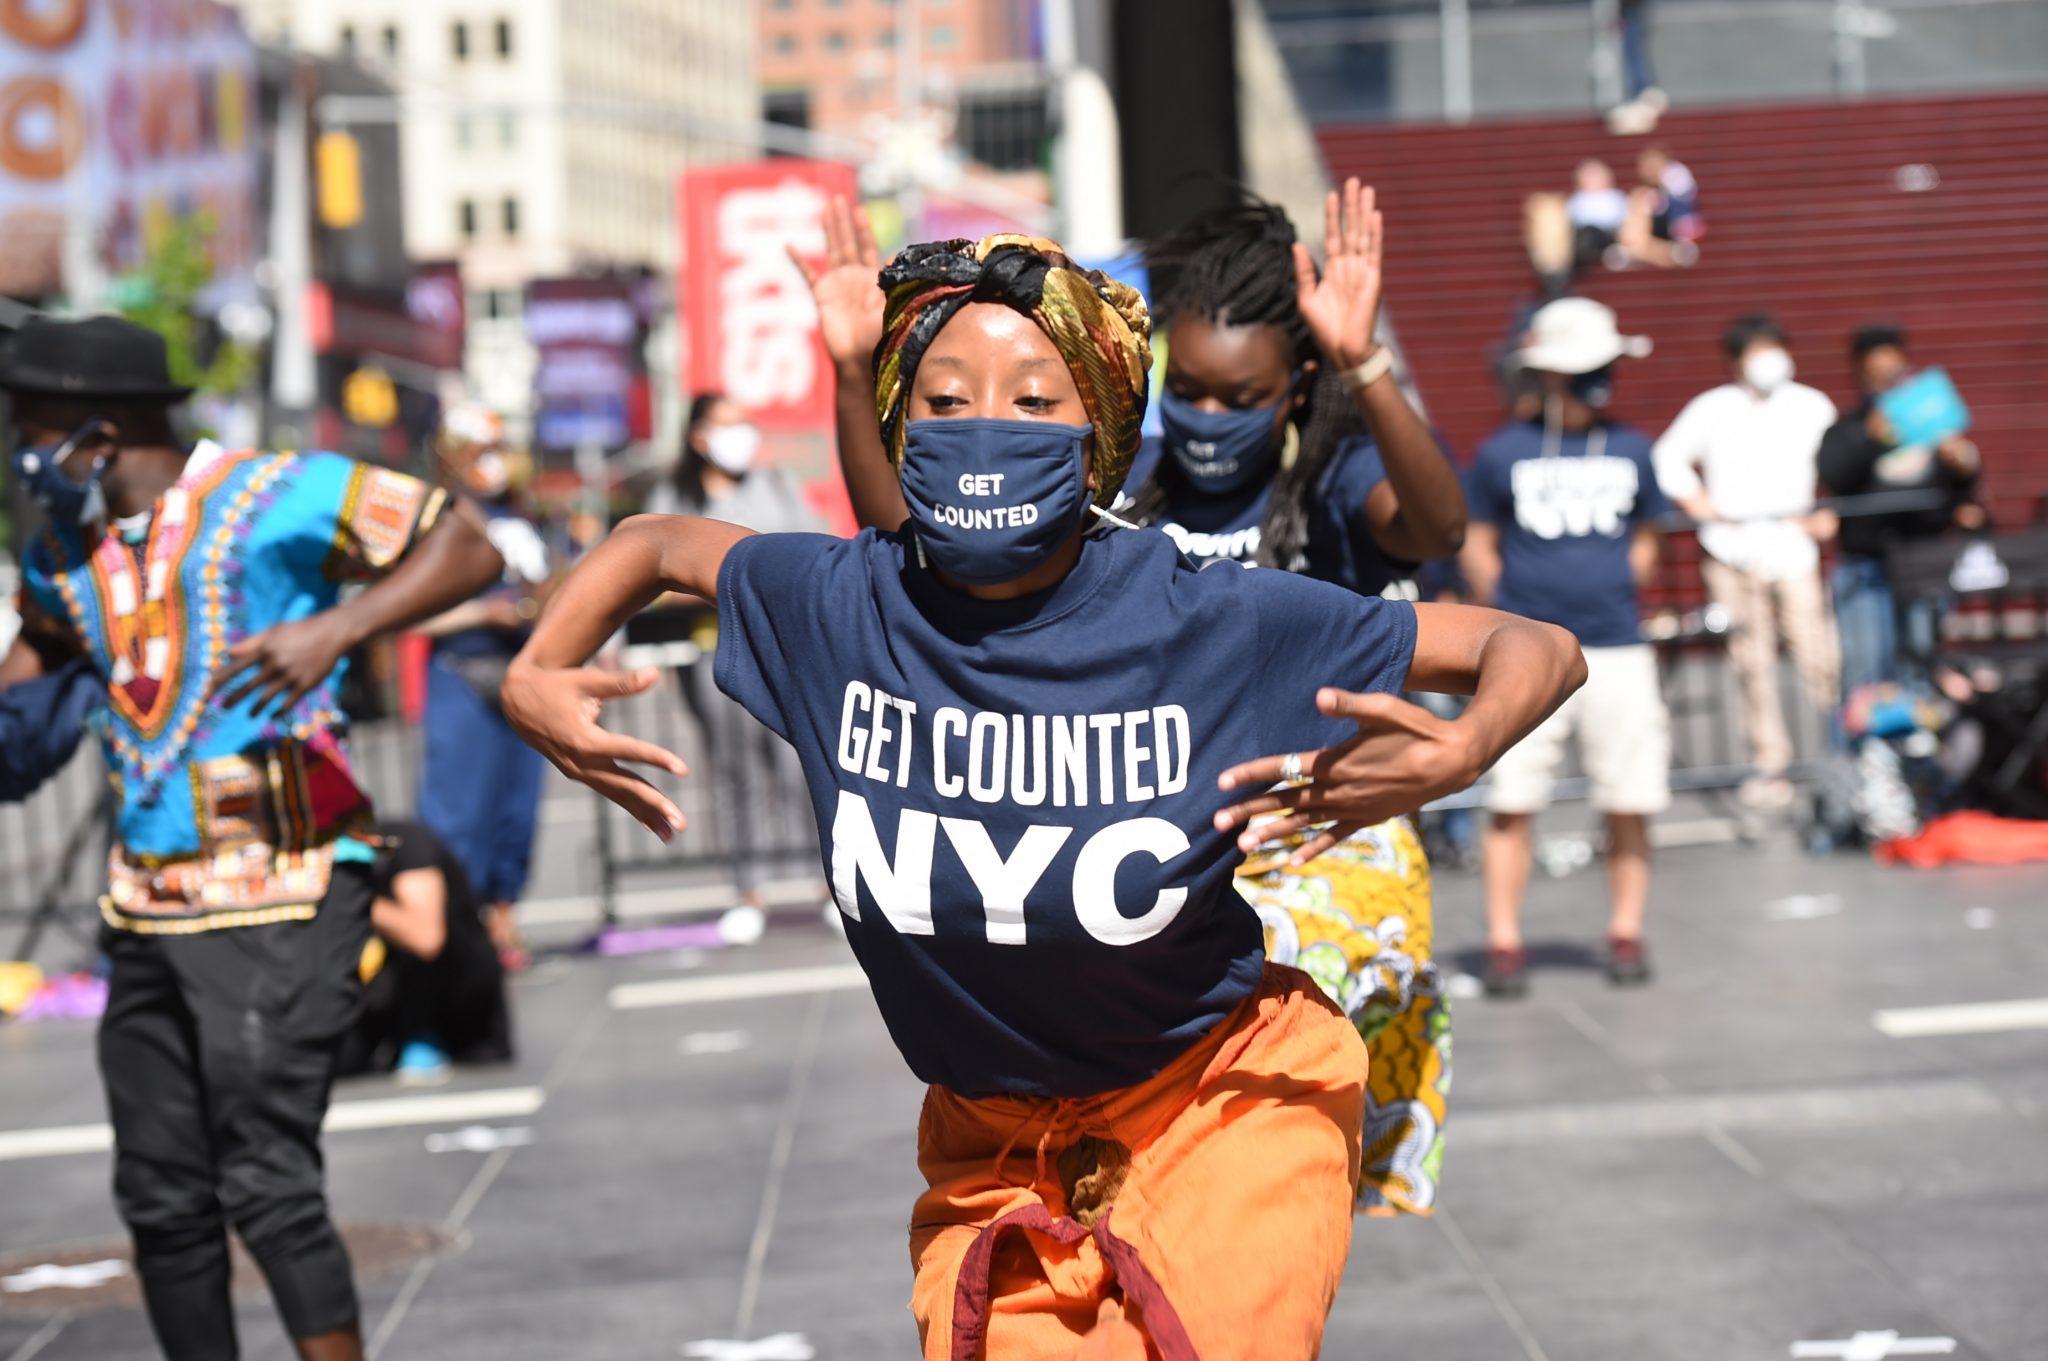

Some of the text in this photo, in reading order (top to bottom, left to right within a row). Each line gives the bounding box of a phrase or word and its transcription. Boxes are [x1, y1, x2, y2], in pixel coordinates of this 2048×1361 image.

[933, 503, 1038, 530] COUNTED
[958, 473, 1005, 496] GET
[838, 680, 1191, 807] GET COUNTED
[832, 790, 1191, 946] NYC
